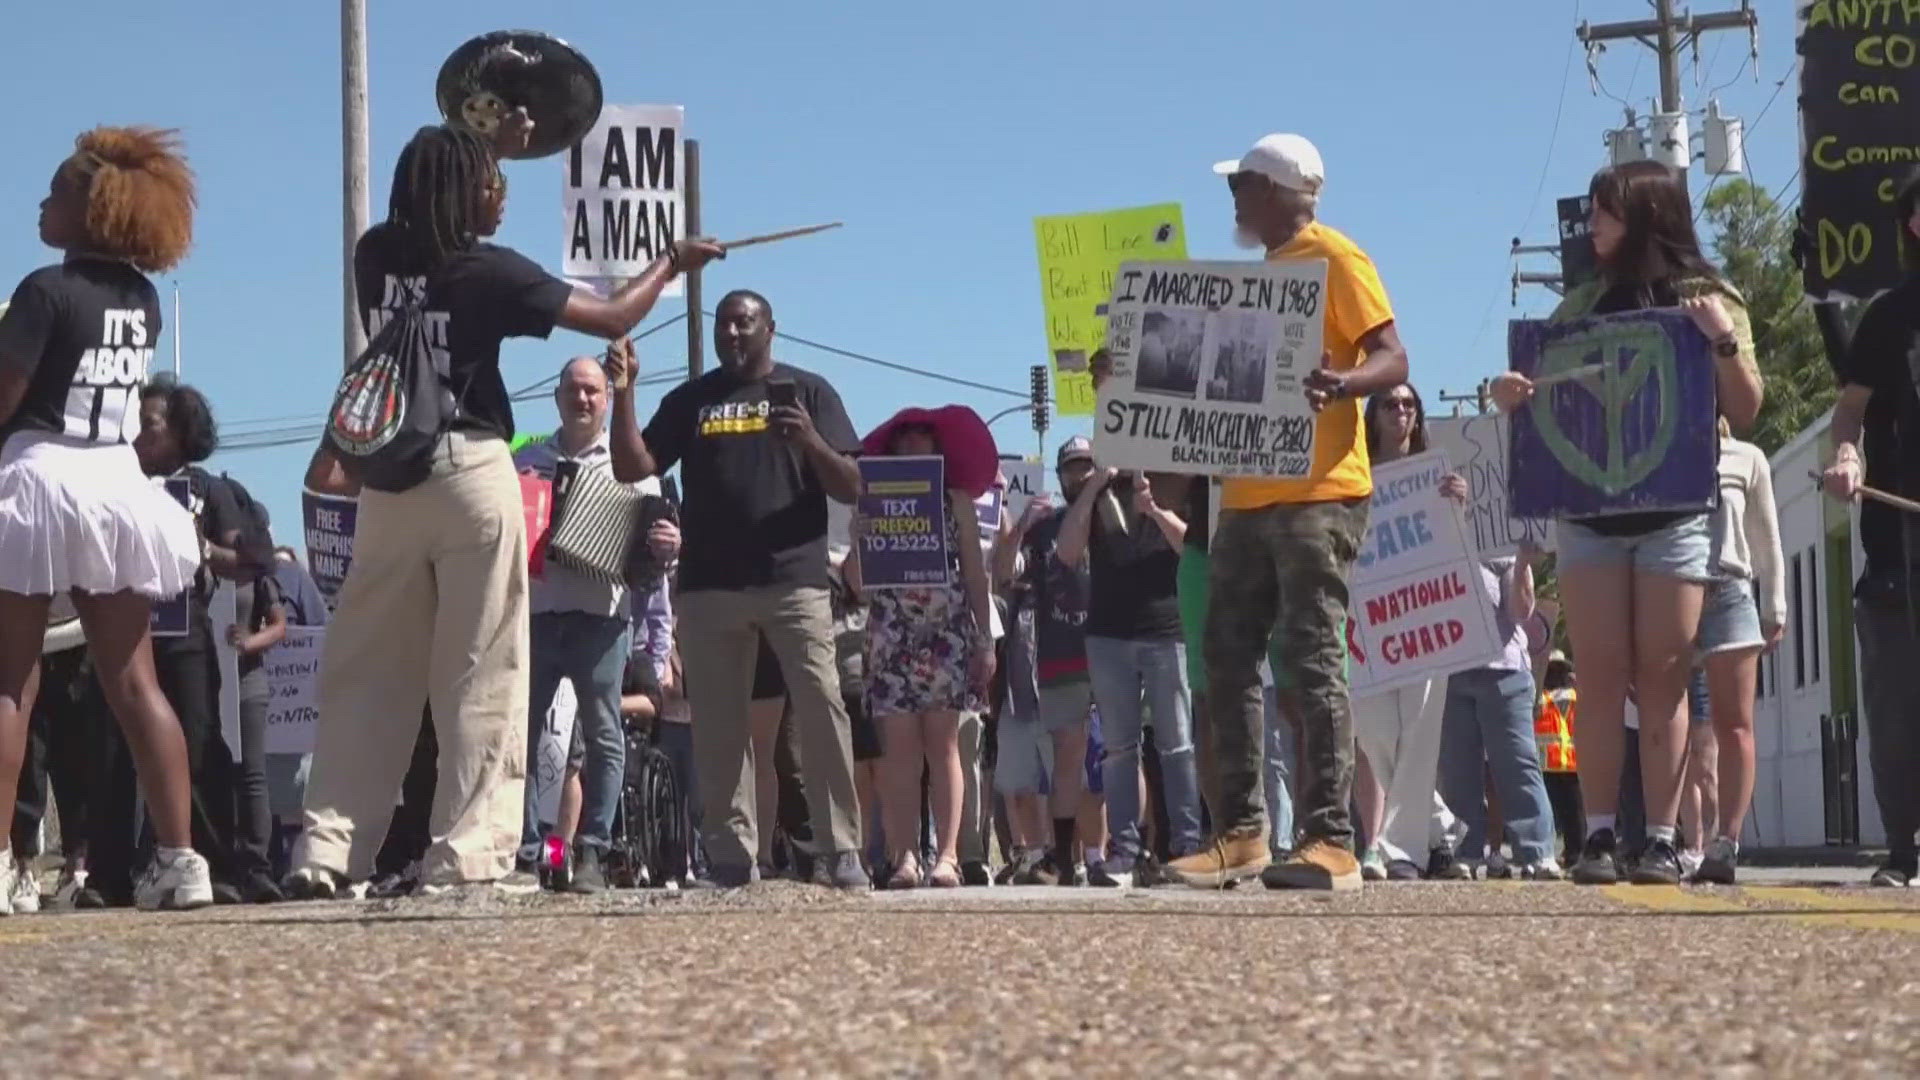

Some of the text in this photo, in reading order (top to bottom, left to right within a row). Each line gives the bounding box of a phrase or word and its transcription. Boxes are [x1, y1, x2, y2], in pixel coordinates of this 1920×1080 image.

[1838, 82, 1900, 104] can
[600, 126, 676, 190] AM
[570, 199, 675, 262] A MAN
[1043, 222, 1080, 259] Bill
[1117, 270, 1143, 304] I
[1142, 270, 1234, 307] MARCHED
[1238, 276, 1273, 312] IN
[1277, 278, 1321, 319] 1968
[102, 308, 148, 346] IT'S
[72, 346, 155, 386] ABOU
[697, 399, 770, 424] FREE-9
[1104, 399, 1170, 441] STILL
[1174, 405, 1268, 451] MARCHING
[1372, 465, 1442, 509] LLECTIVE
[316, 508, 341, 532] FREE
[871, 517, 932, 534] FREE901
[882, 498, 918, 516] TEXT
[306, 529, 354, 558] MEMPHIS
[864, 534, 941, 552] TO 25225
[1365, 571, 1467, 628] NATIONAL
[1381, 619, 1464, 666] GUARD
[267, 706, 320, 725] CONTRO
